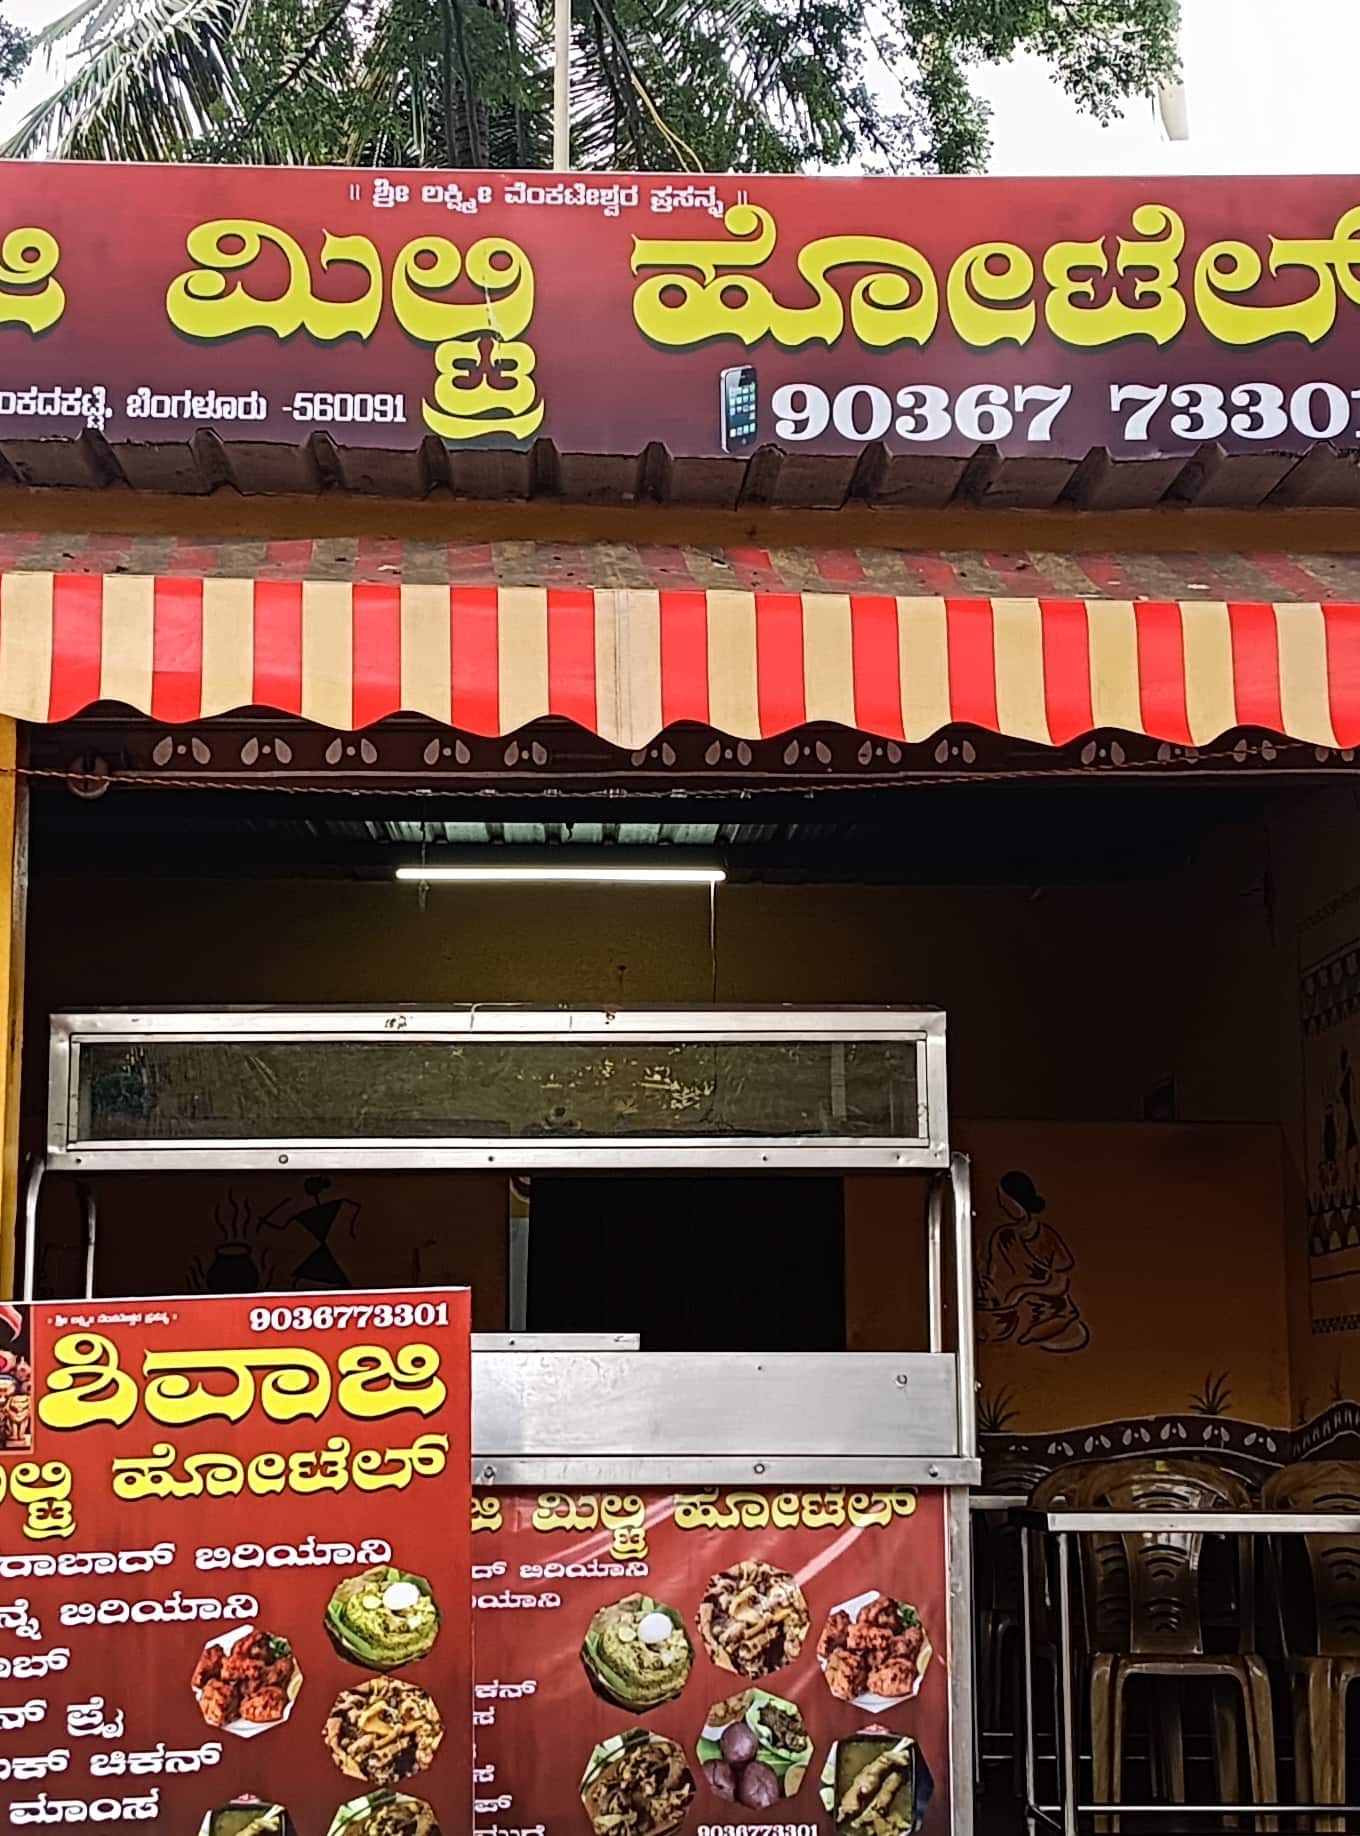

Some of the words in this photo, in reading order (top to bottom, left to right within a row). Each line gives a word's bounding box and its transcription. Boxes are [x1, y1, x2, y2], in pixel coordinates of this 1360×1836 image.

[372, 178, 409, 208] ಶ್ರೀ
[166, 217, 546, 440] ಮಿಲ್ಟ್ರಿ
[126, 387, 267, 422] ಬೆಂಗಳೂರು
[771, 382, 1071, 443] 90367
[249, 1302, 449, 1333] 9036773301
[38, 1331, 448, 1431] ಶಿವಾಜಿ
[111, 1433, 450, 1501] ಹೋಟೆಲ್
[195, 1536, 393, 1572] ಬಿರಿಯಾನಿ
[59, 1591, 260, 1626] ಬಿರಿಯಾನಿ
[89, 1742, 224, 1777] ಚಿಕನ್
[8, 1787, 160, 1825] ಮಾಂಸ
